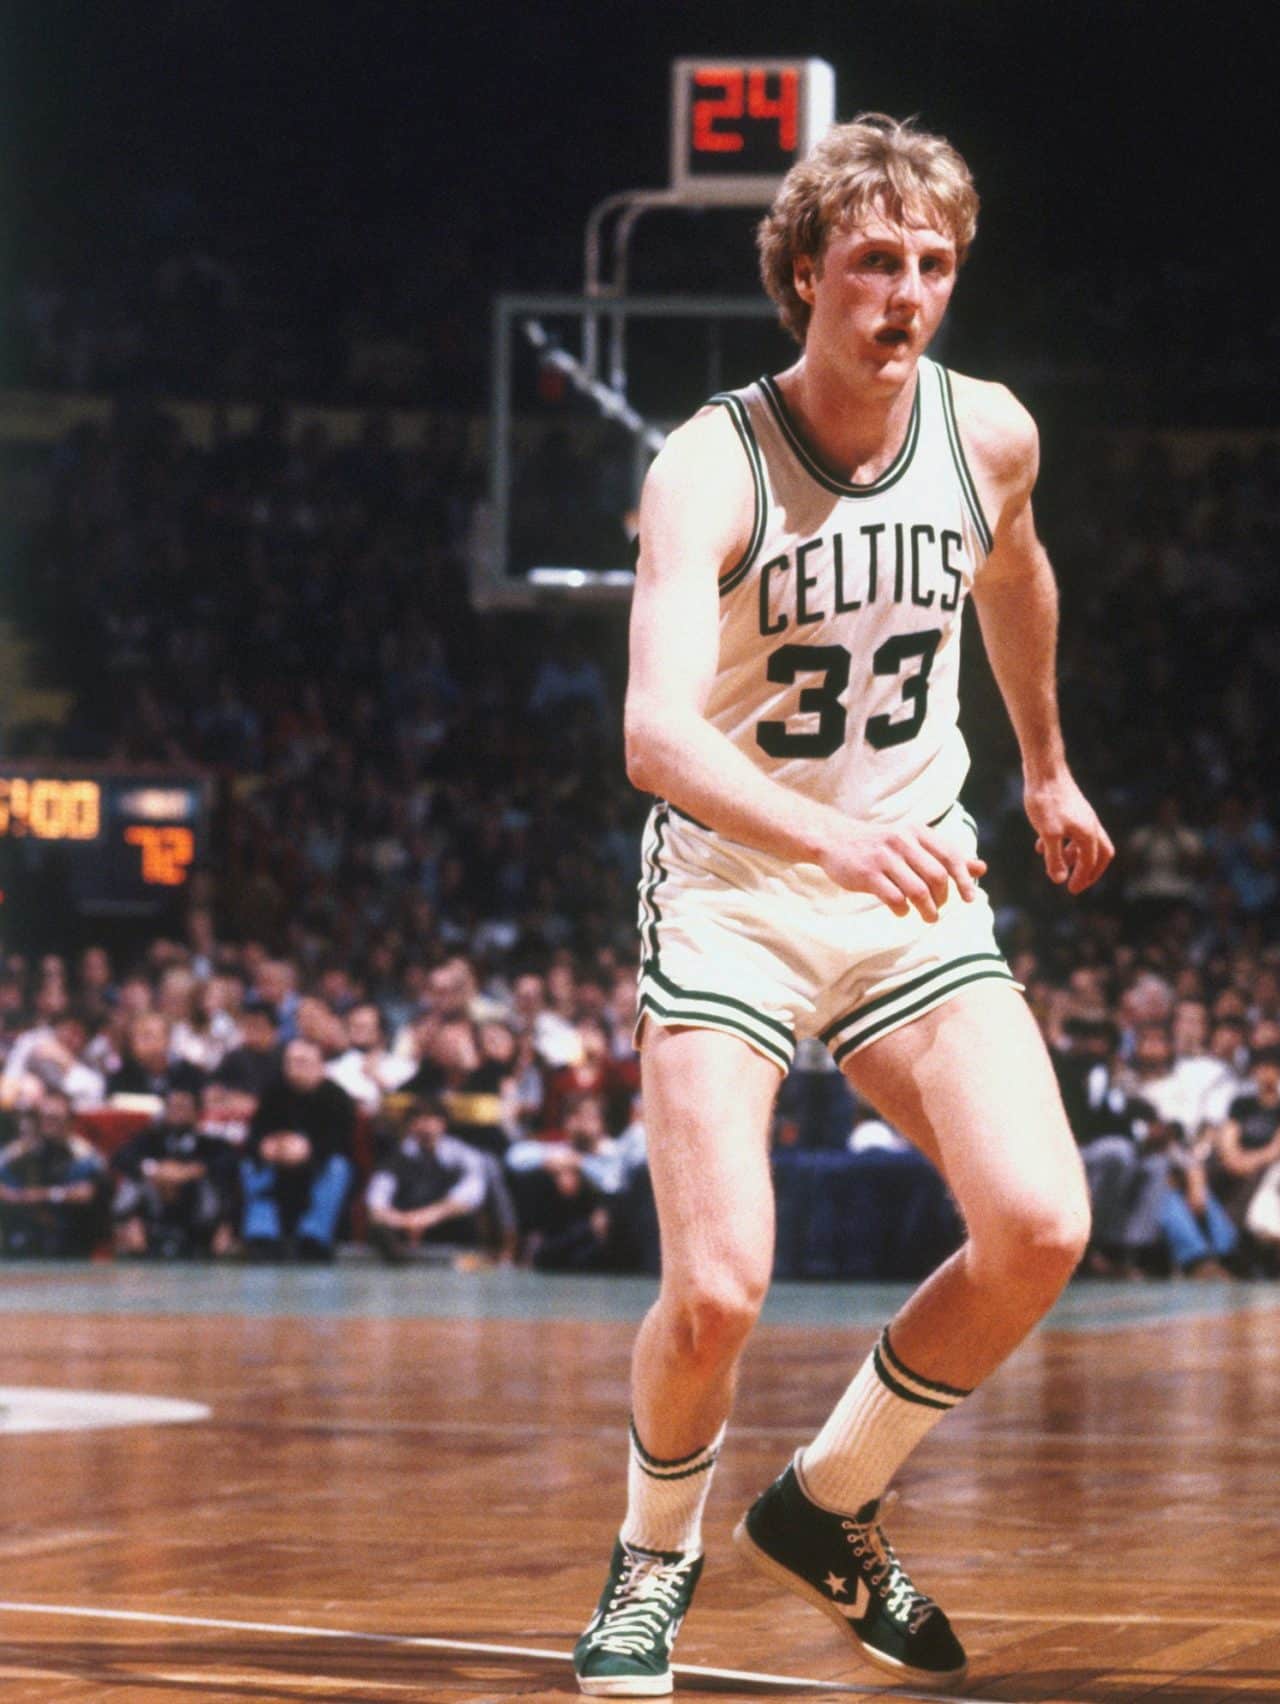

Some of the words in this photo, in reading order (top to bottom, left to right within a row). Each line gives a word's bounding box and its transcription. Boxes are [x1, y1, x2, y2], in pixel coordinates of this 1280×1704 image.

[692, 67, 798, 153] 24
[759, 523, 962, 636] CELTICS
[756, 628, 942, 759] 33
[124, 825, 194, 885] 72
